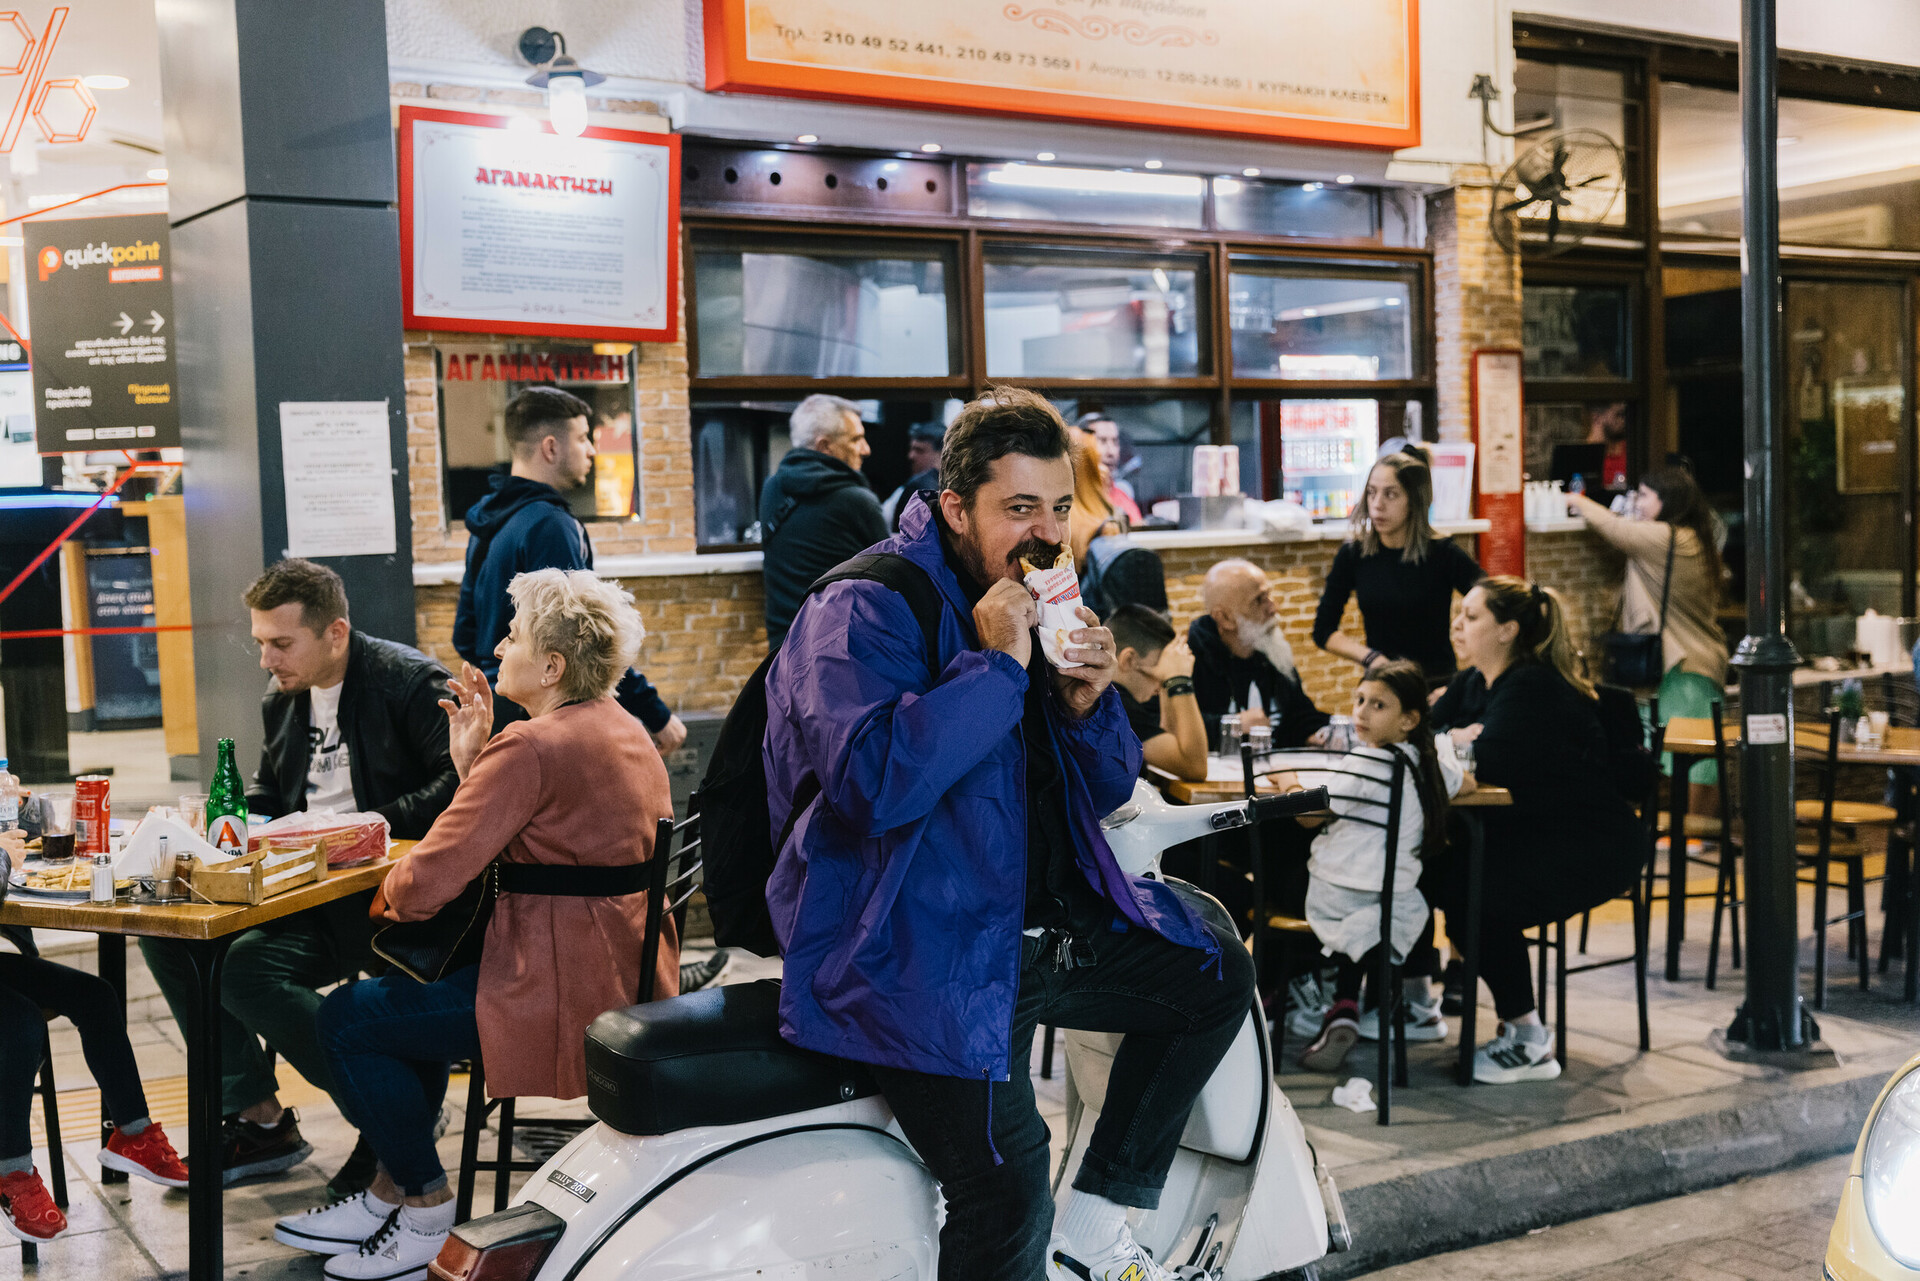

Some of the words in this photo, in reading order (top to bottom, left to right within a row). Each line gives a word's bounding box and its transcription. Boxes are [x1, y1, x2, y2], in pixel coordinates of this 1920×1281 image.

[822, 29, 856, 47] 210
[860, 36, 883, 50] 49
[887, 38, 909, 53] 52
[956, 47, 987, 62] 210
[991, 50, 1013, 65] 49
[1017, 53, 1038, 68] 73
[1041, 56, 1072, 71] 569
[475, 166, 613, 197] ΑΓΑΝΑΚΤΗΣΗ
[64, 240, 161, 269] quickpoint
[446, 352, 625, 382] ΑΓΑΝΑΚΤΗΣΗ
[552, 1172, 571, 1185] rally
[570, 1182, 587, 1195] 200
